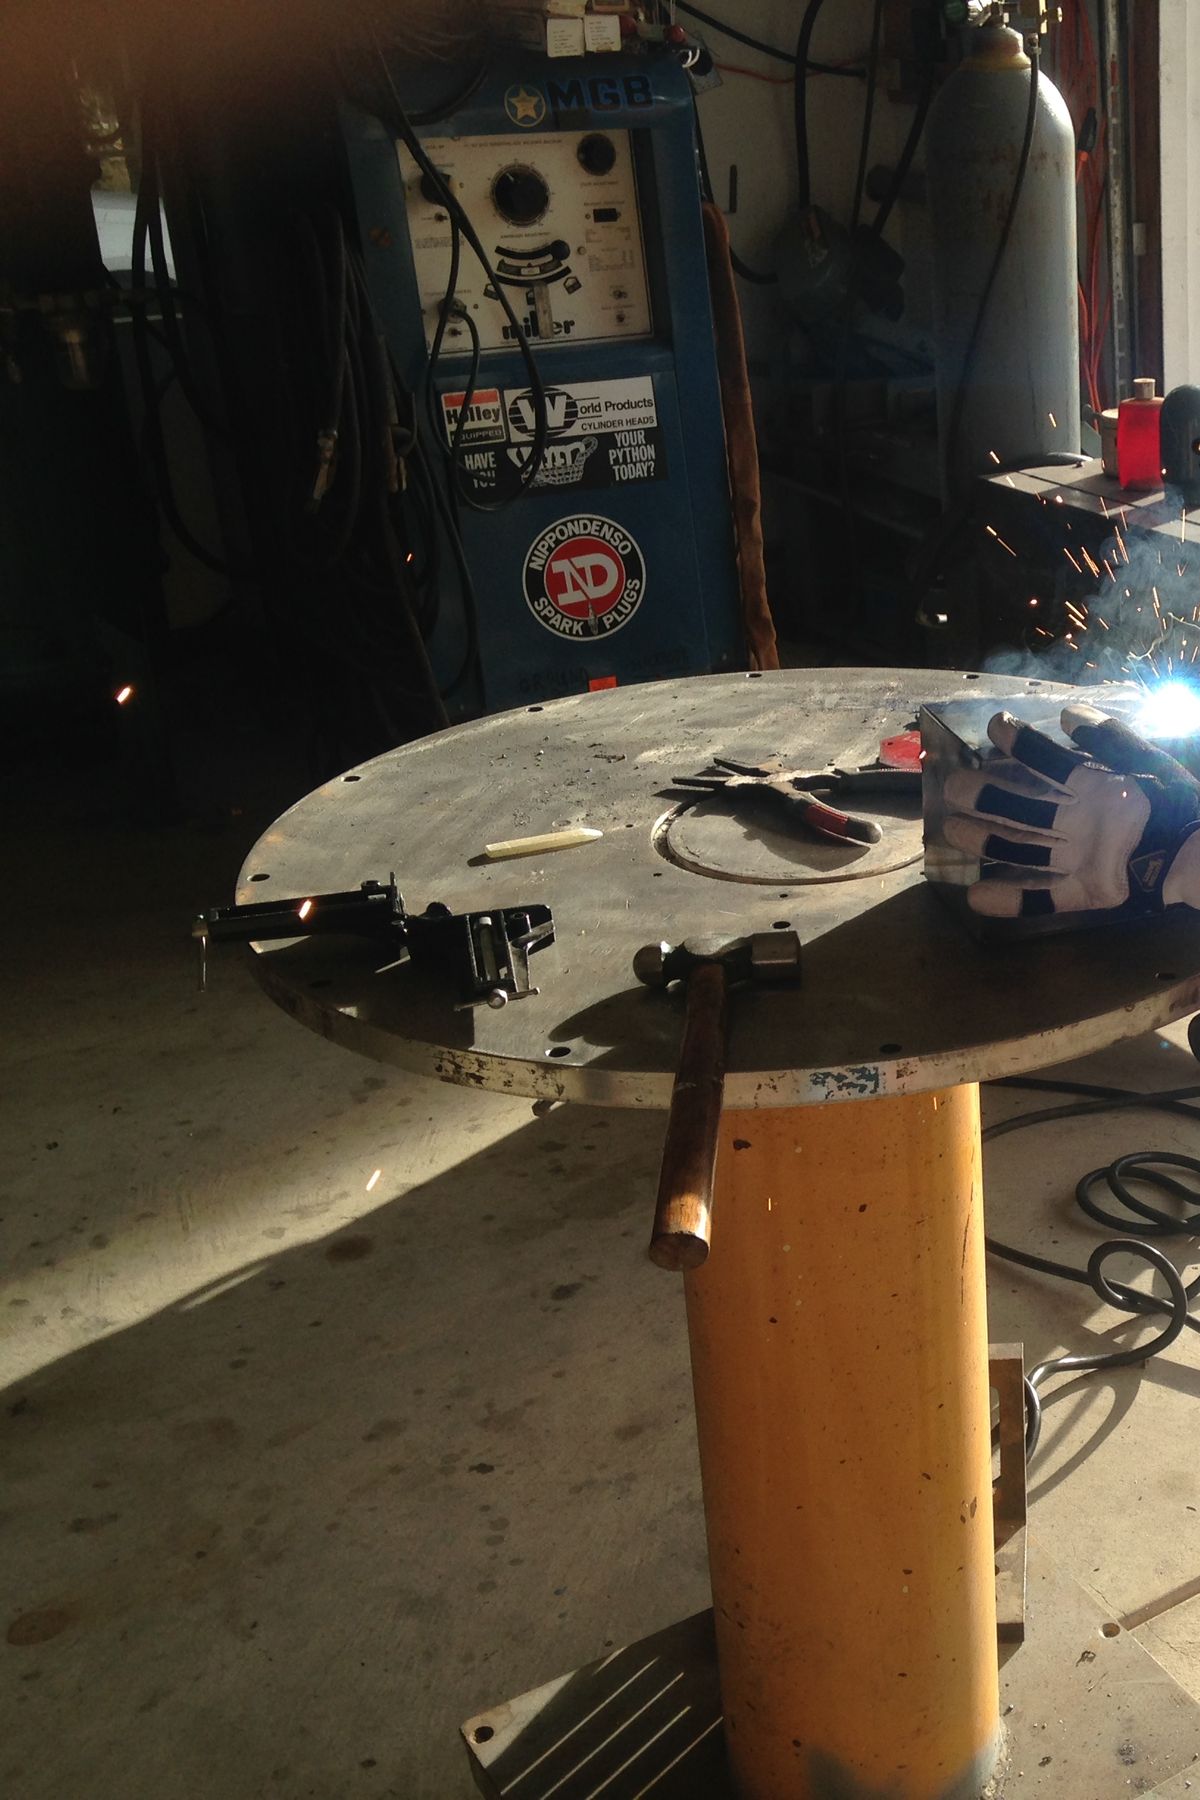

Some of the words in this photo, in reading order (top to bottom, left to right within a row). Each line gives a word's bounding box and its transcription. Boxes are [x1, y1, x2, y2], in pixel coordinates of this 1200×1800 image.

[546, 75, 654, 112] MGB
[502, 310, 575, 340] miler
[446, 405, 501, 425] Hlley
[604, 397, 654, 413] Products
[581, 418, 623, 431] CYLINDER
[625, 416, 655, 428] HEADS
[614, 430, 647, 447] YOUR
[464, 451, 496, 470] HAVE
[608, 445, 656, 465] PYTHON
[613, 461, 655, 481] TODAY?
[528, 519, 632, 572] NIPPONDENSO
[551, 552, 619, 606] ND
[534, 597, 584, 635] SPARK
[602, 578, 640, 629] PLUGS
